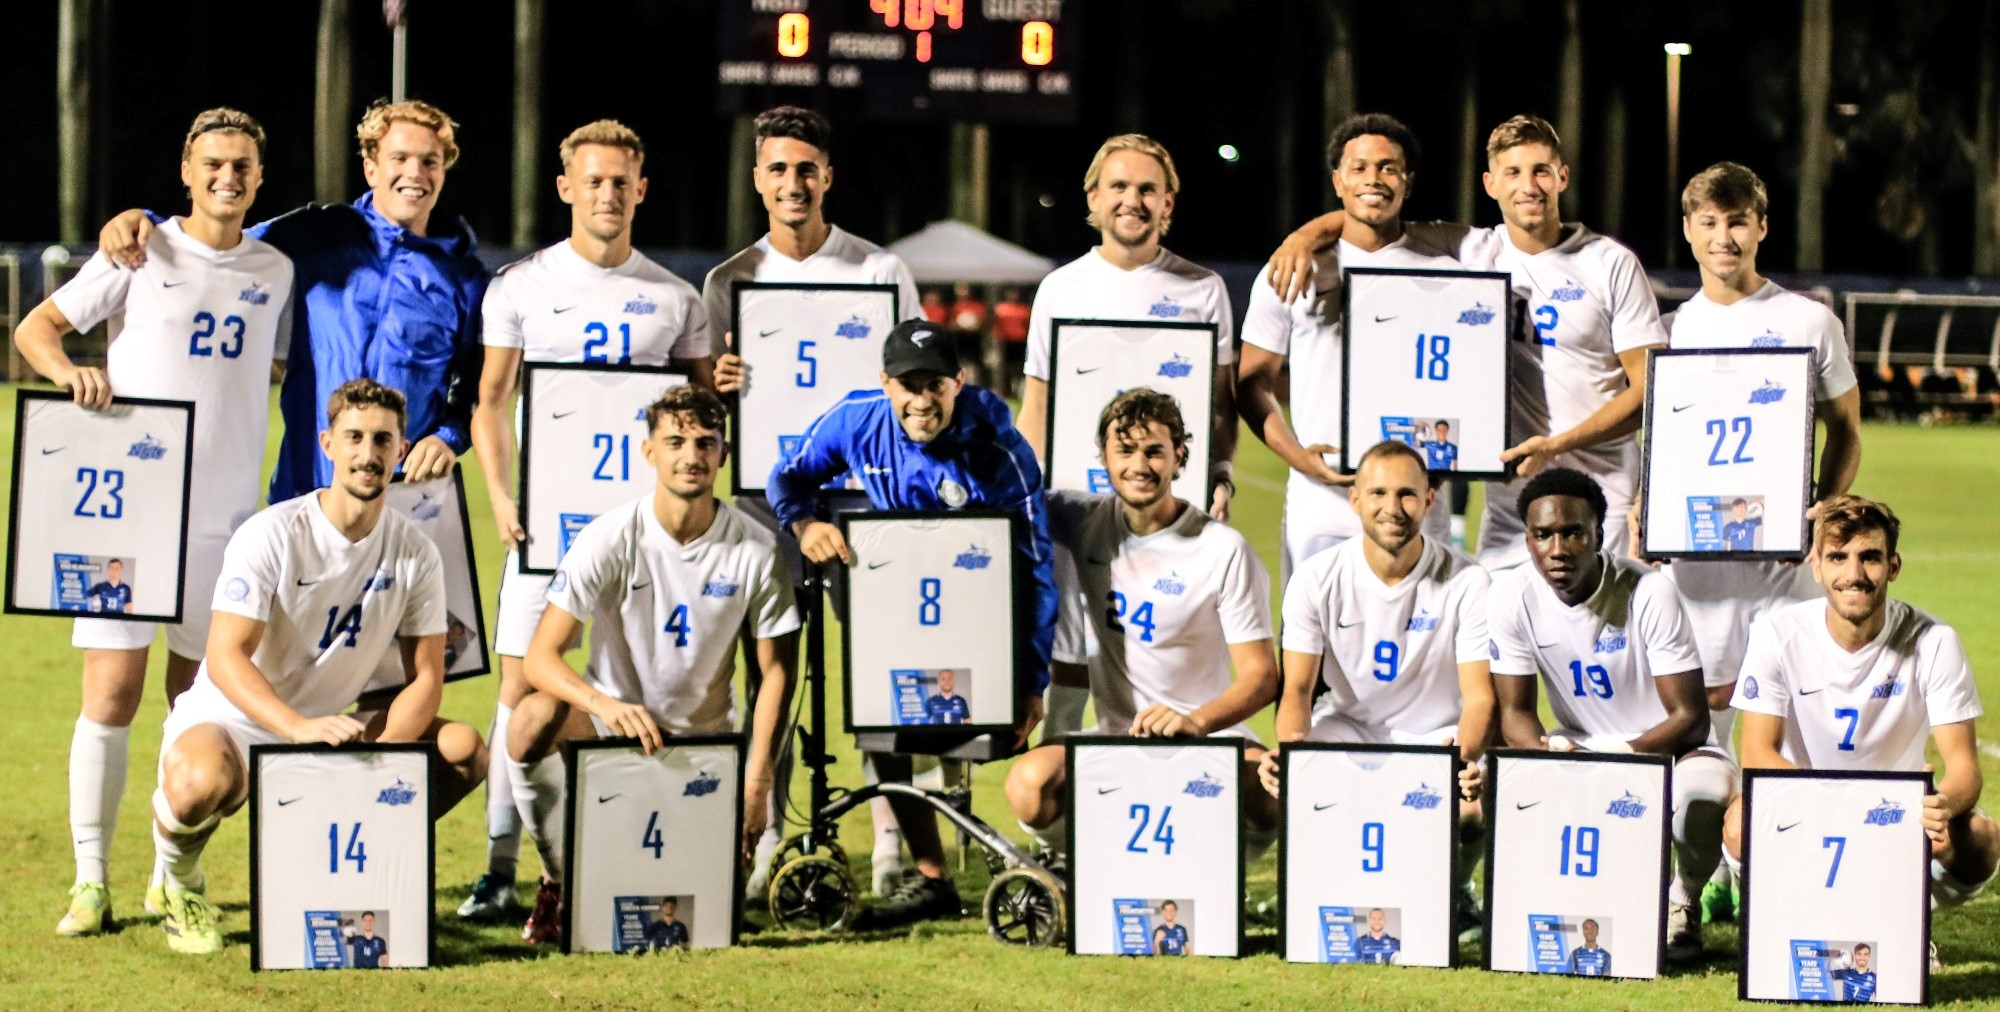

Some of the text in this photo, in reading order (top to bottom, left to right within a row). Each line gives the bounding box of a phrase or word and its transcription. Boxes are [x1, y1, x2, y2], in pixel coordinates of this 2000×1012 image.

[777, 12, 810, 58] 0
[915, 31, 932, 63] 1
[1021, 20, 1053, 66] 0
[189, 312, 246, 359] 23
[583, 321, 632, 364] 21
[1415, 333, 1450, 382] 18
[795, 340, 817, 389] 5
[592, 433, 630, 482] 21
[1706, 416, 1754, 466] 22
[74, 467, 124, 519] 23
[319, 603, 364, 649] 14
[663, 602, 692, 648] 4
[919, 577, 941, 627] 8
[1106, 591, 1156, 643] 24
[1373, 639, 1400, 683] 9
[1569, 659, 1614, 700] 19
[1834, 707, 1860, 752] 7
[329, 822, 367, 874] 14
[641, 810, 664, 860] 4
[1126, 803, 1175, 856] 24
[1361, 821, 1385, 873] 9
[1560, 825, 1601, 878] 19
[1822, 836, 1847, 889] 7
